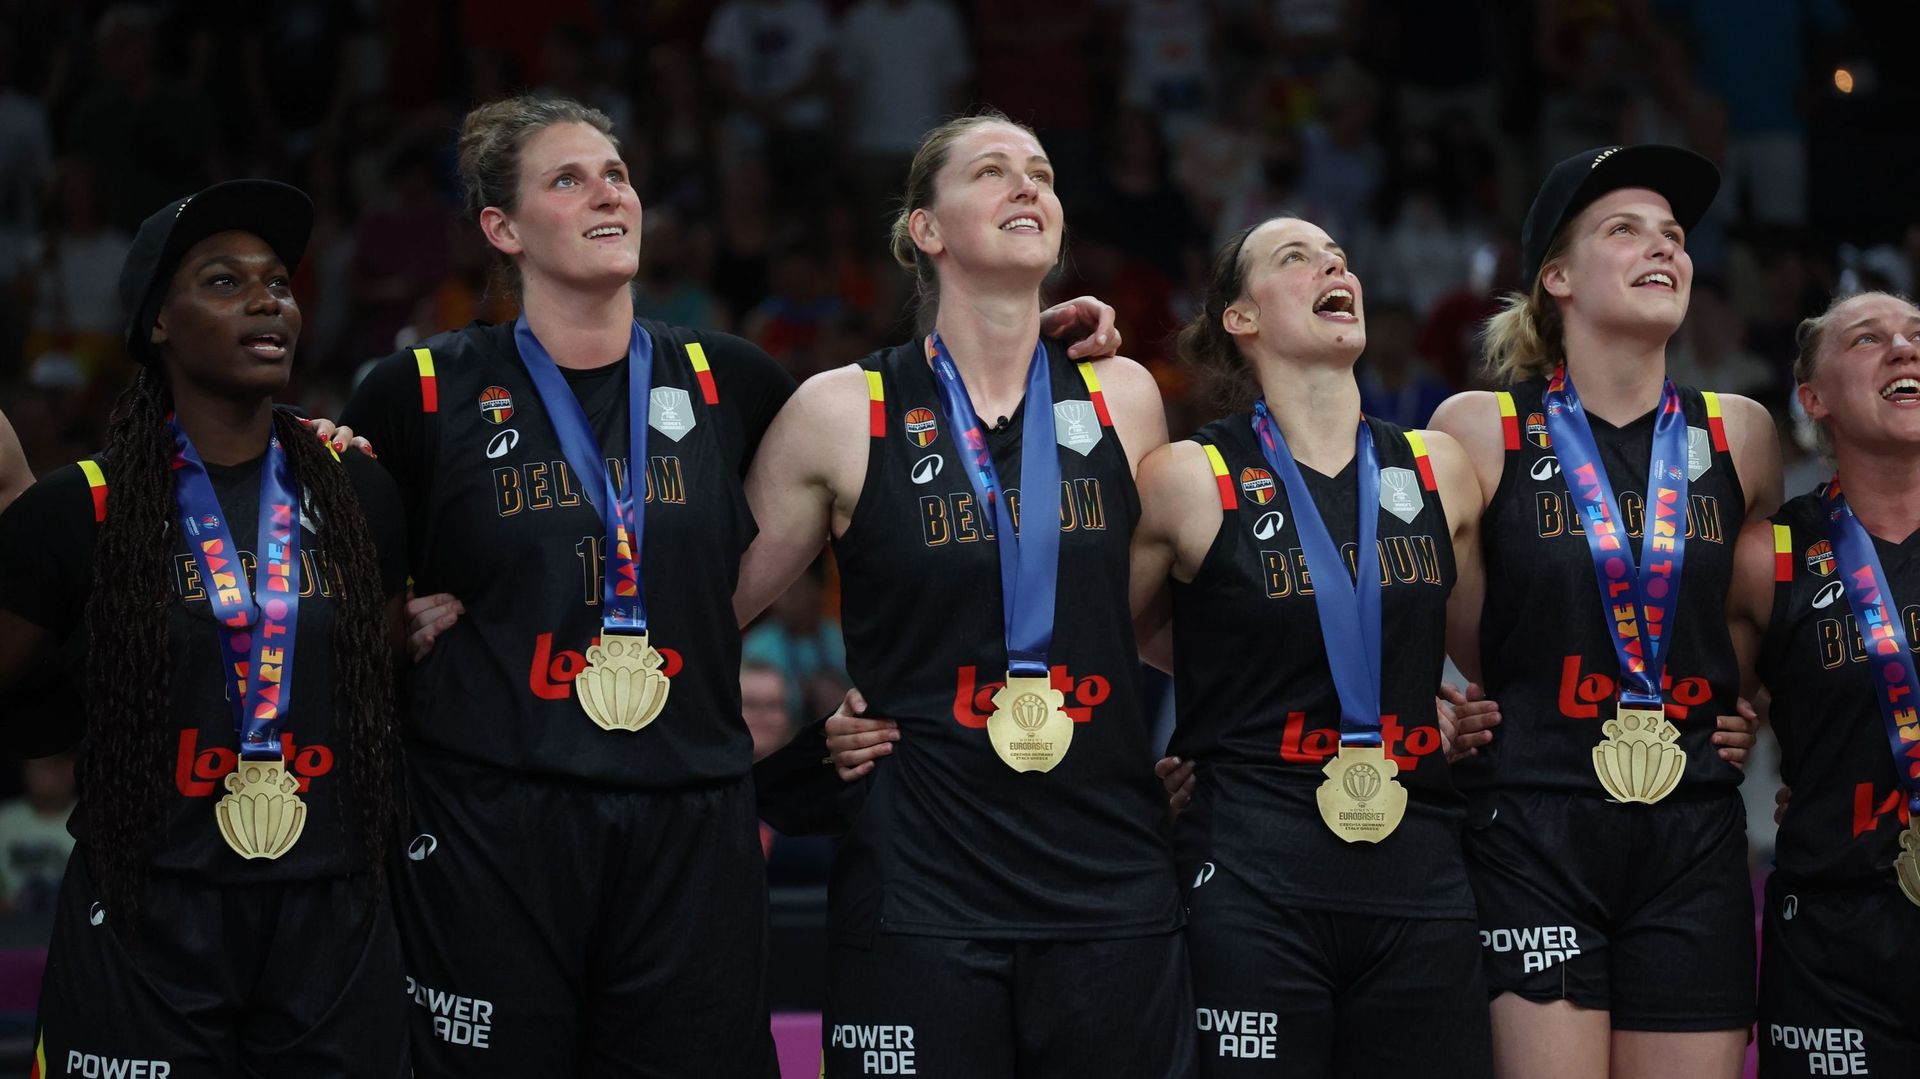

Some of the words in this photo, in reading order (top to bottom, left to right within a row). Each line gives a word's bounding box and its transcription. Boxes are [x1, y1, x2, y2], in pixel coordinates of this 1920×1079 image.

[1573, 463, 1622, 551] DREAM
[1652, 488, 1679, 552] DARE
[266, 504, 292, 592] DREAM
[200, 538, 244, 607] DARE
[1605, 556, 1630, 598] TO
[1647, 559, 1673, 599] TO
[263, 598, 288, 638] TO
[1851, 564, 1901, 655] DREAM
[1613, 602, 1646, 673] DARE
[255, 645, 285, 720] DARE
[1883, 661, 1911, 703] TO
[1279, 711, 1441, 771] Loto
[1606, 714, 1676, 742] 2025
[1338, 811, 1386, 821] EUROBASKET
[433, 1016, 491, 1049] ADE
[831, 1024, 915, 1049] POWER
[1195, 1007, 1279, 1035] OWER
[1770, 1023, 1866, 1051] POWER
[66, 1049, 171, 1079] POWER
[863, 1050, 917, 1075] ADE
[1219, 1034, 1277, 1059] ADE
[1808, 1051, 1869, 1076] ADE
